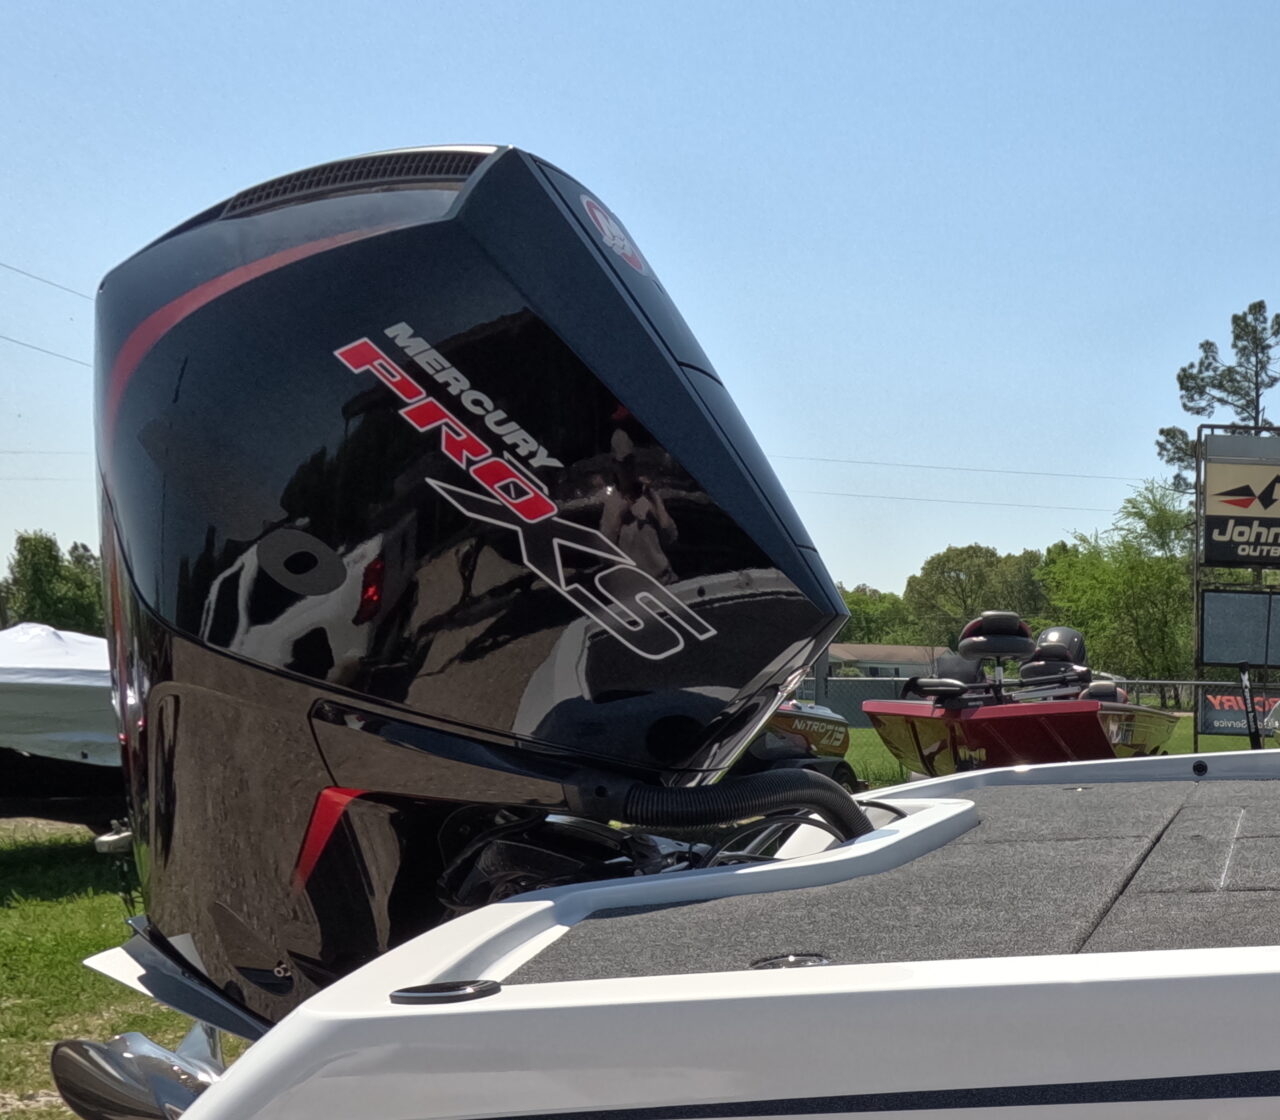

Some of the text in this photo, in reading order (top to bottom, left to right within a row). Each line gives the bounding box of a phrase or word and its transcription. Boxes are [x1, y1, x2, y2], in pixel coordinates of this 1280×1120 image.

[333, 337, 558, 523] PRO
[383, 321, 564, 470] MERCURY
[424, 450, 718, 660] XS
